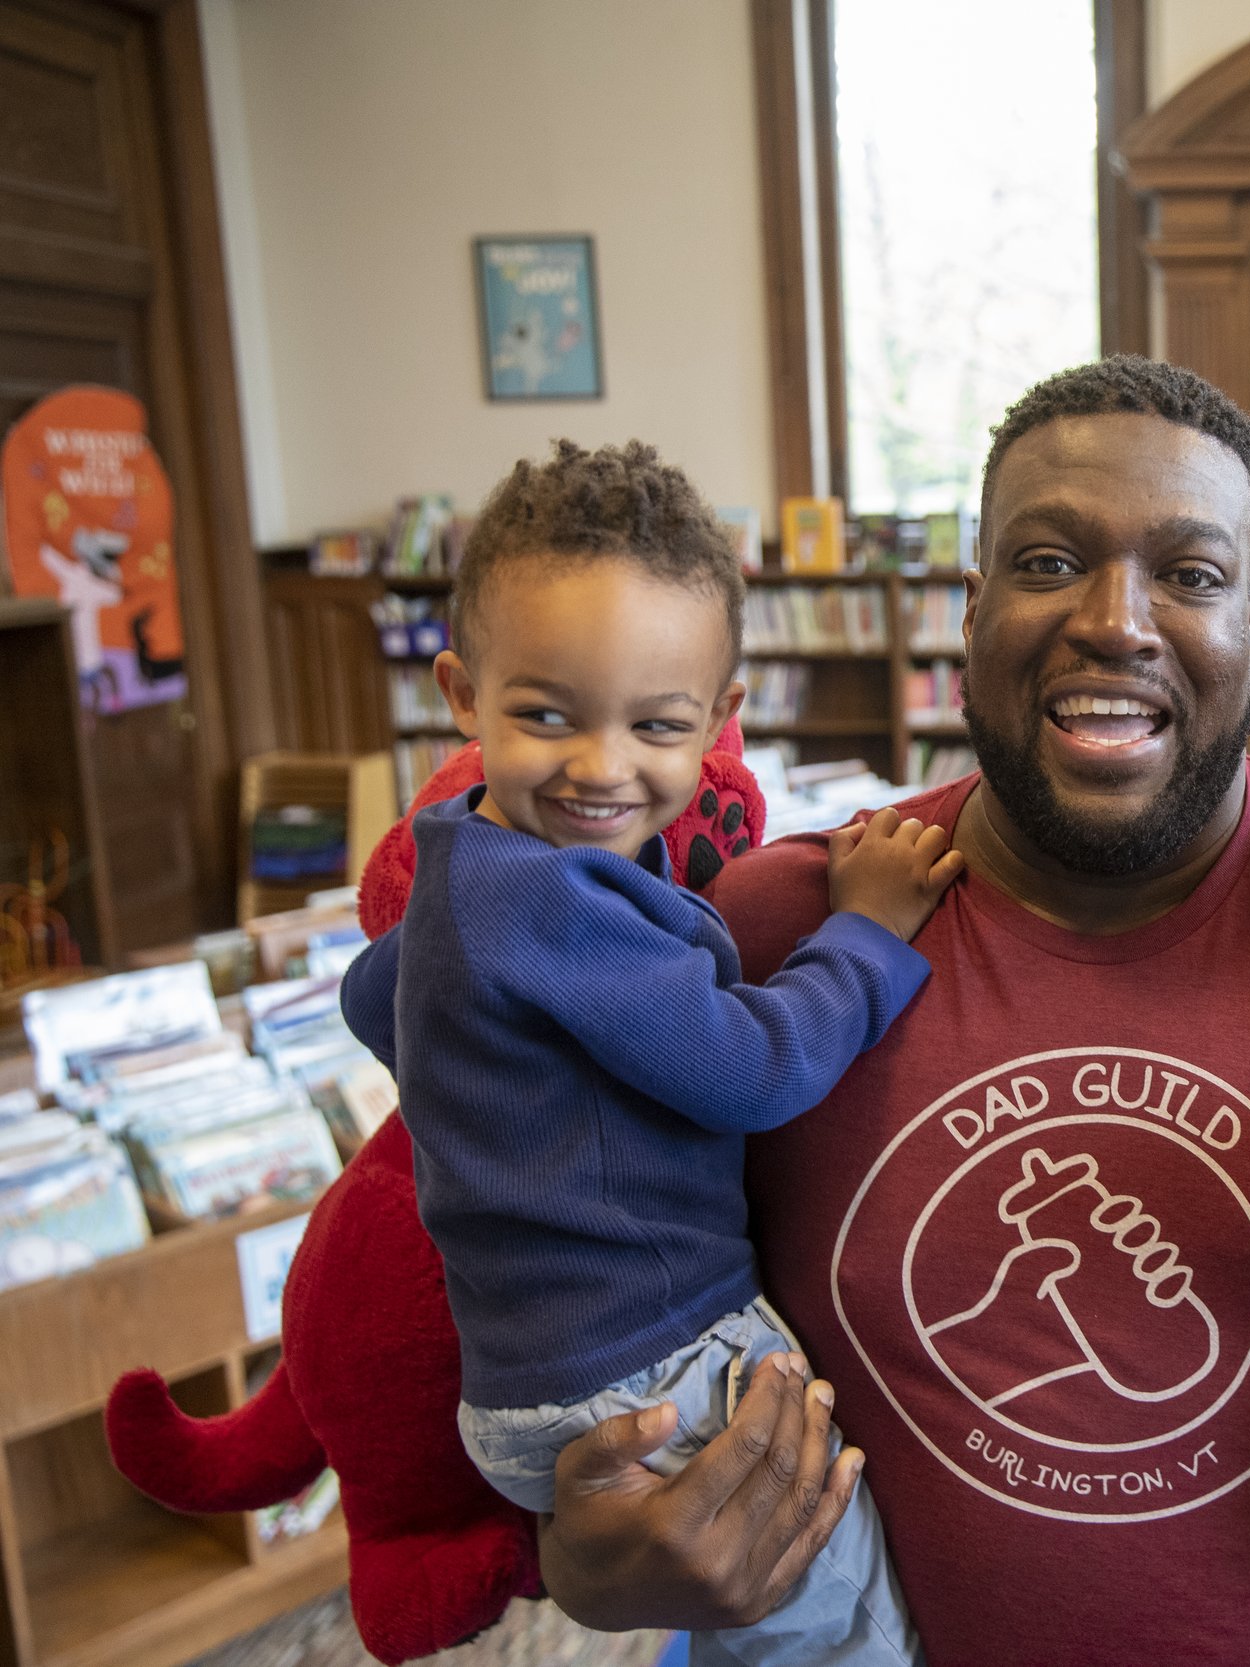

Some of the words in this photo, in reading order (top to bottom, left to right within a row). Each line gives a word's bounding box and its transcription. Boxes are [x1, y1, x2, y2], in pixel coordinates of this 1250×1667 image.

[942, 1075, 1049, 1149] DAD
[1072, 1062, 1242, 1151] GUILD
[965, 1428, 1173, 1496] BURLINGTON,
[1177, 1441, 1219, 1477] VT
